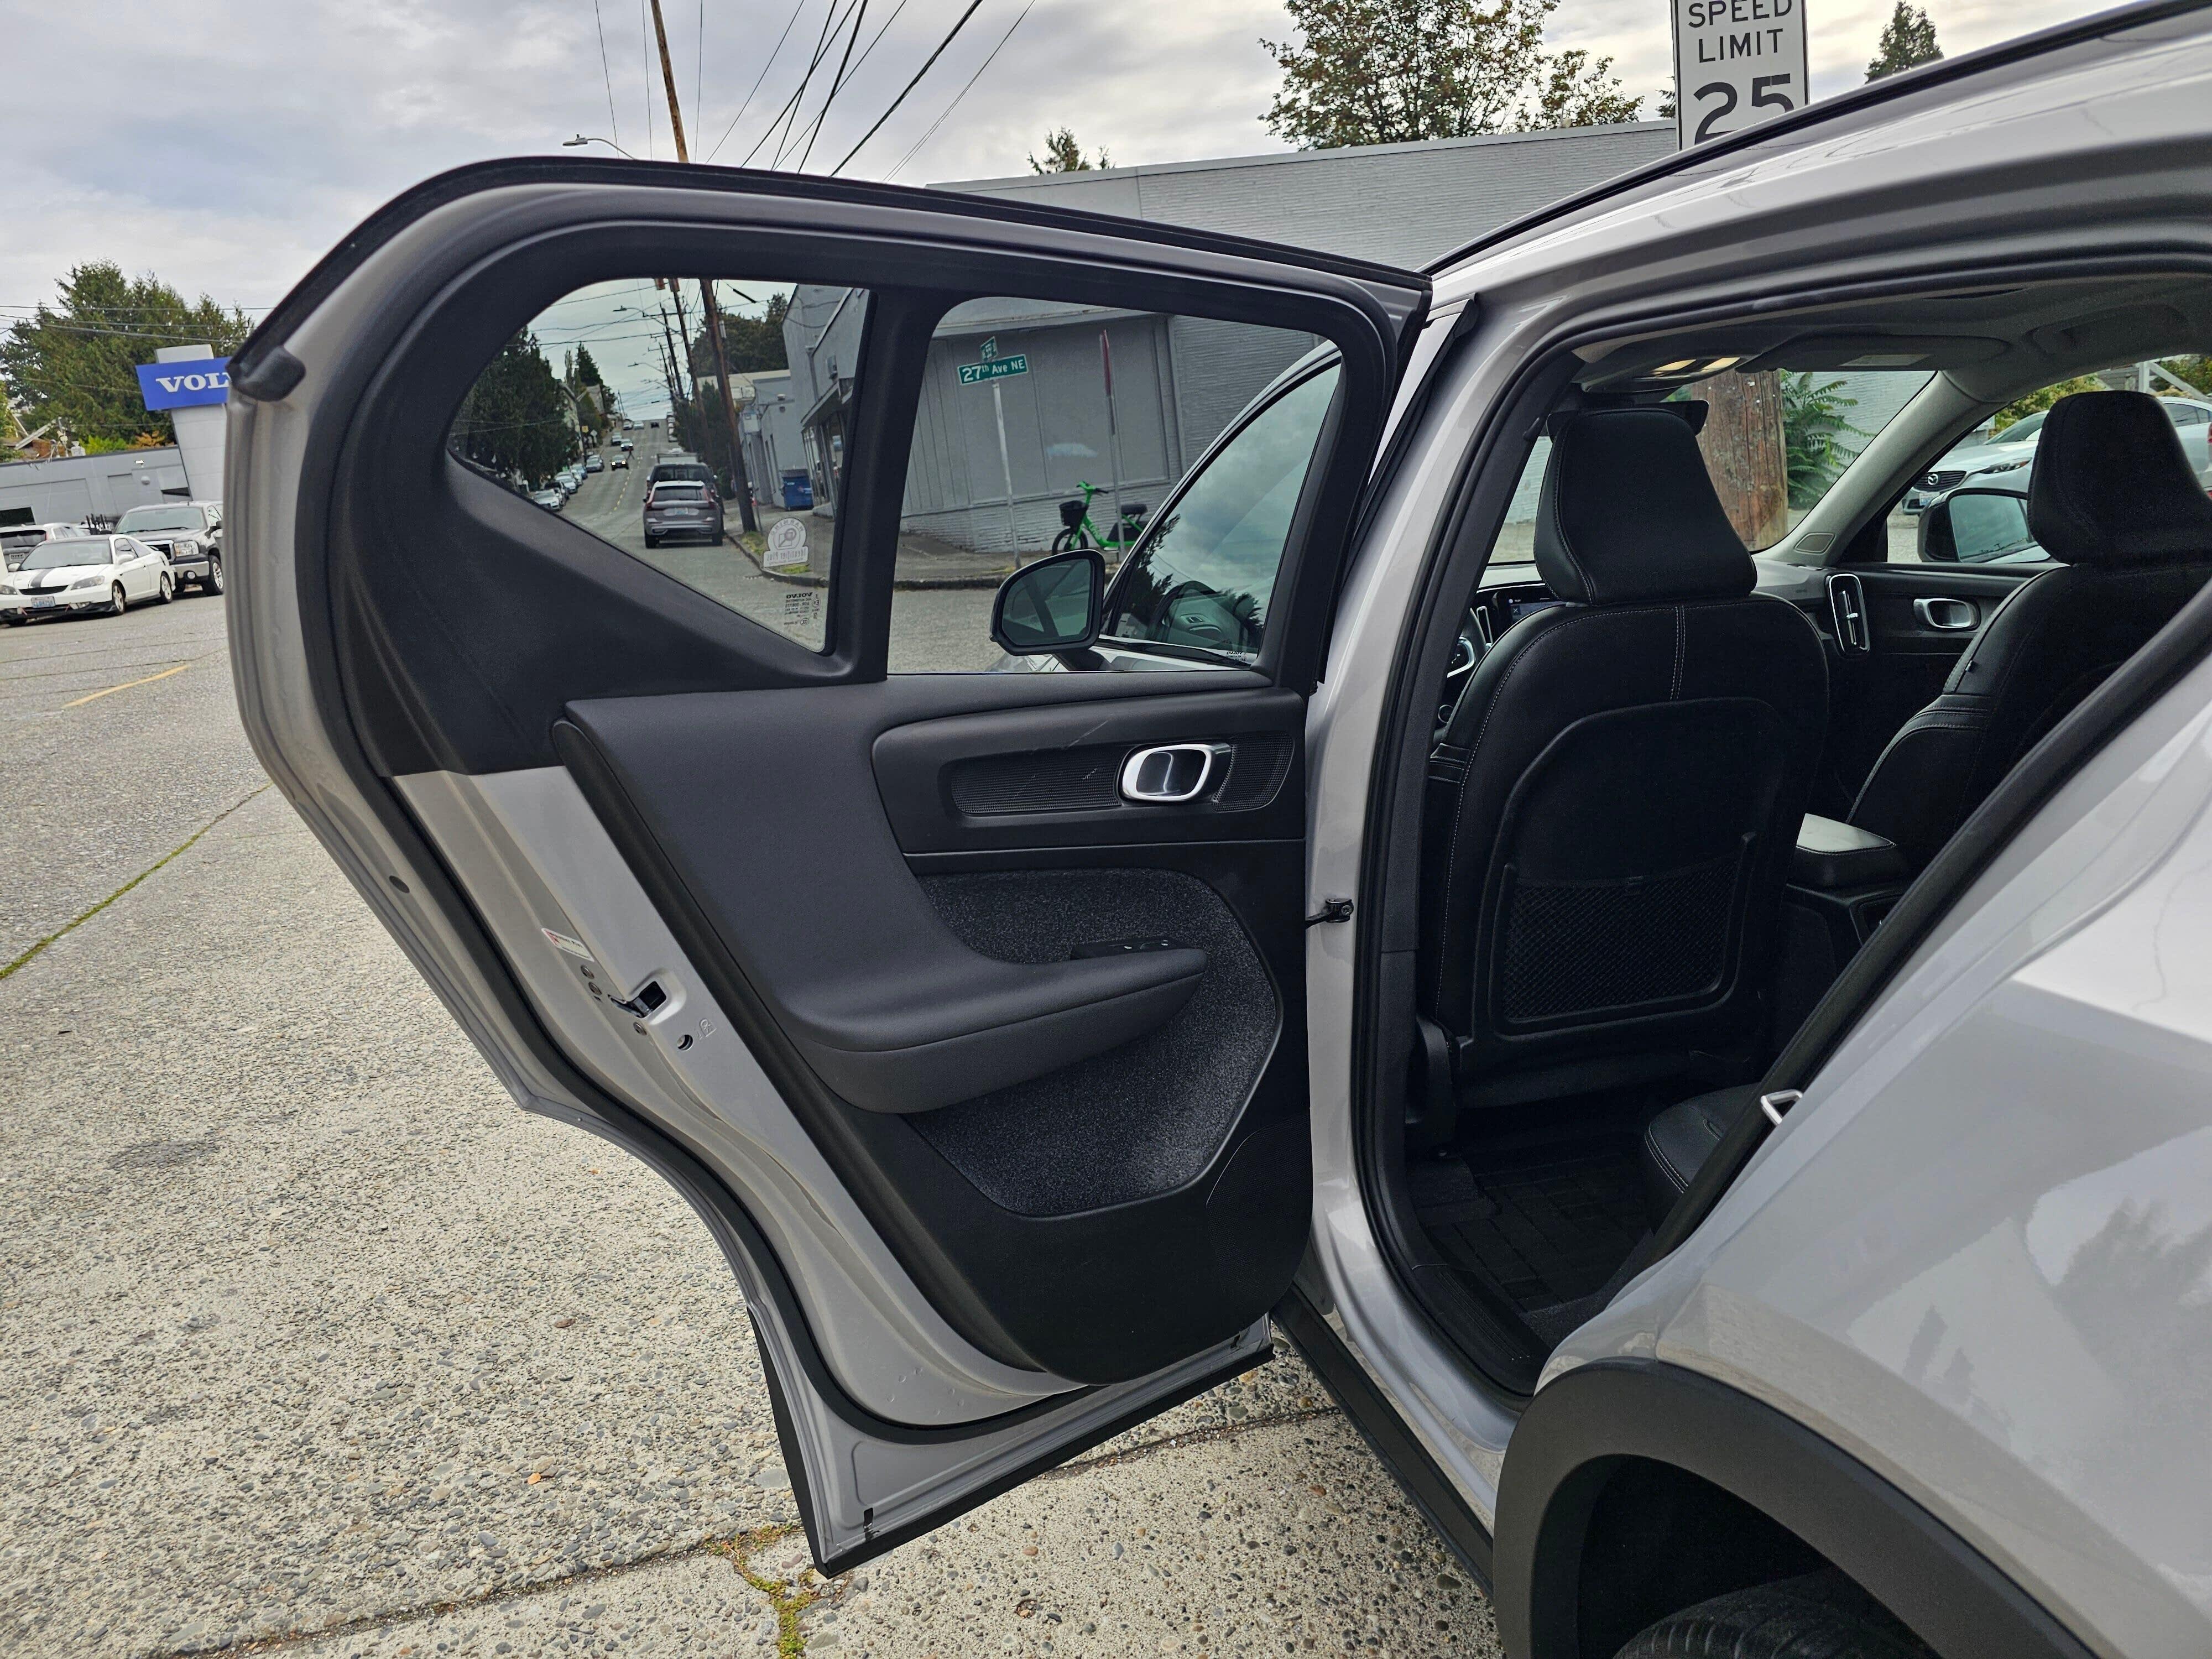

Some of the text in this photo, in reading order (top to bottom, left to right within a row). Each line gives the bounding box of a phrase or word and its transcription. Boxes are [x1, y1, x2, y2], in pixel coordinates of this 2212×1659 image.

[1688, 0, 1792, 28] SPEED
[1698, 28, 1783, 63] LIMIT
[1693, 73, 1794, 145] 25
[156, 372, 231, 393] VOL
[962, 359, 1025, 382] 27th Ave NE
